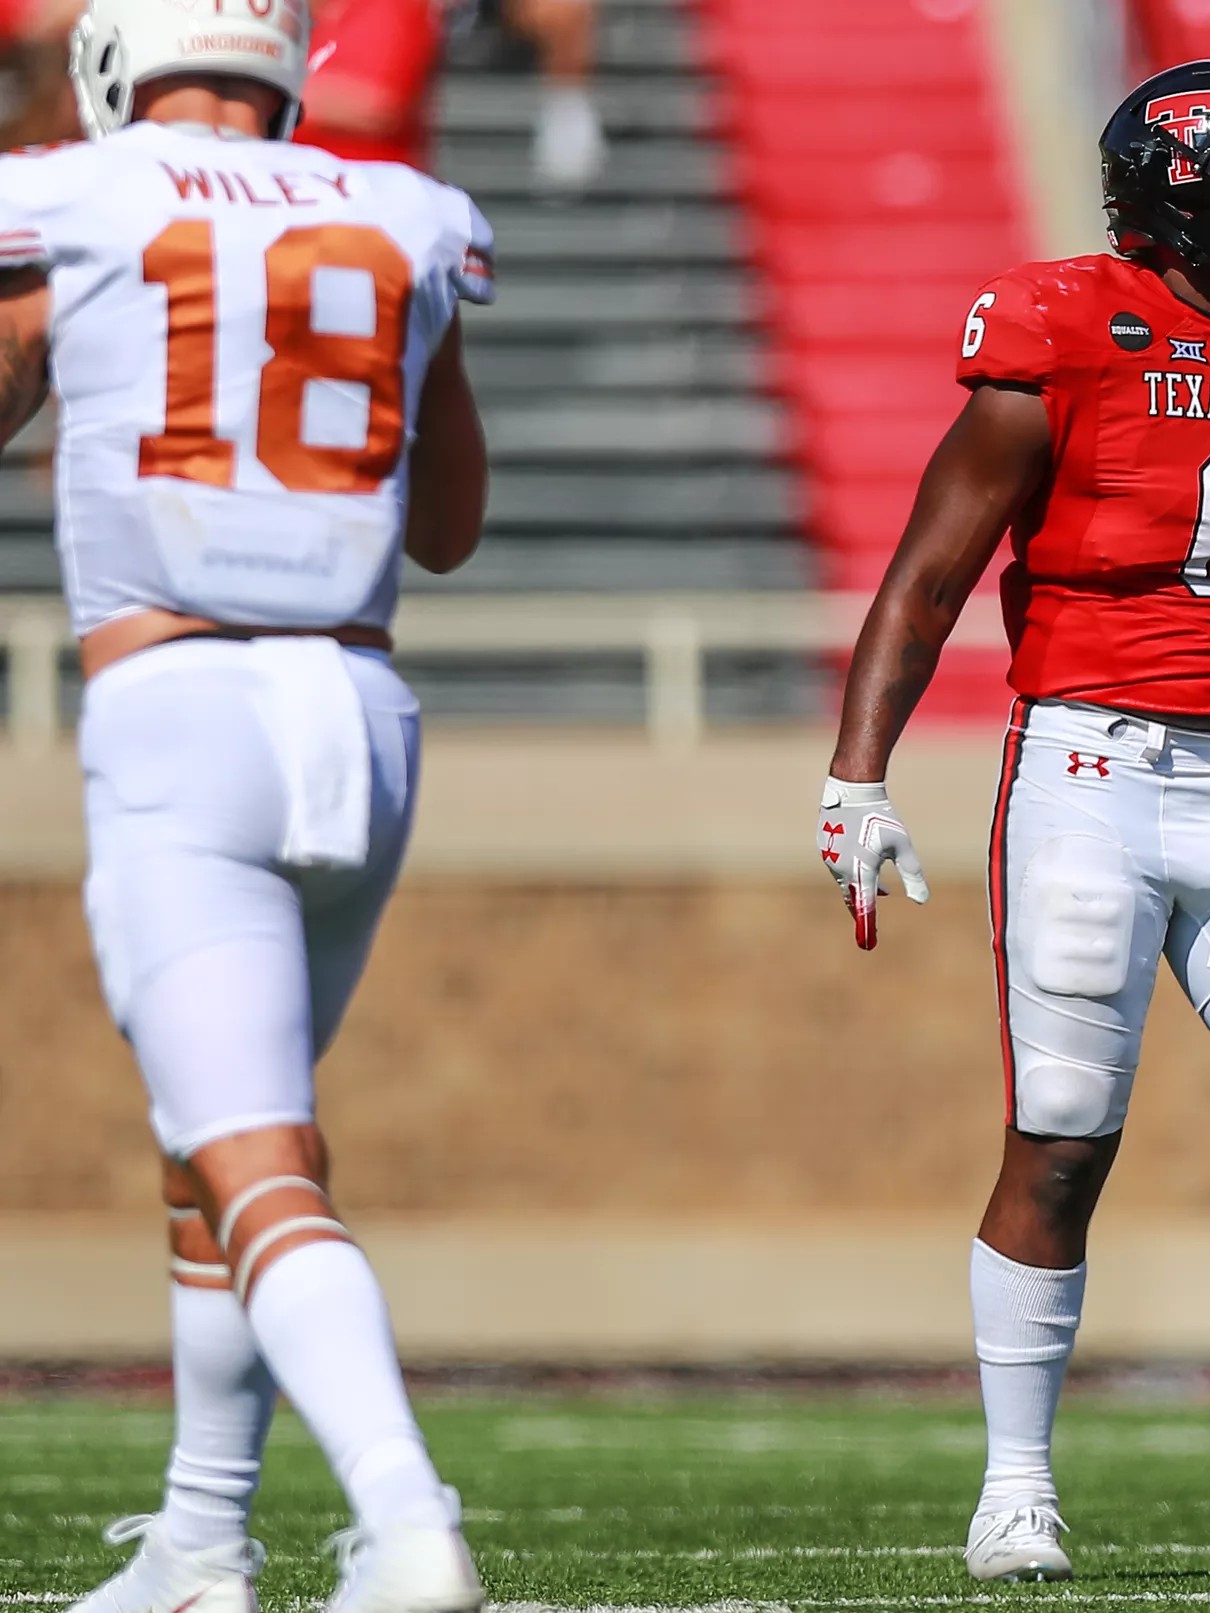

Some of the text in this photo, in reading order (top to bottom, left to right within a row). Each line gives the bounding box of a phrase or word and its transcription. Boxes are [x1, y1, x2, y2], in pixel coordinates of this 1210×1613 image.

[159, 160, 350, 207] WILEY
[961, 291, 997, 360] 6
[1110, 325, 1150, 337] EQUALITY
[138, 217, 413, 494] 18
